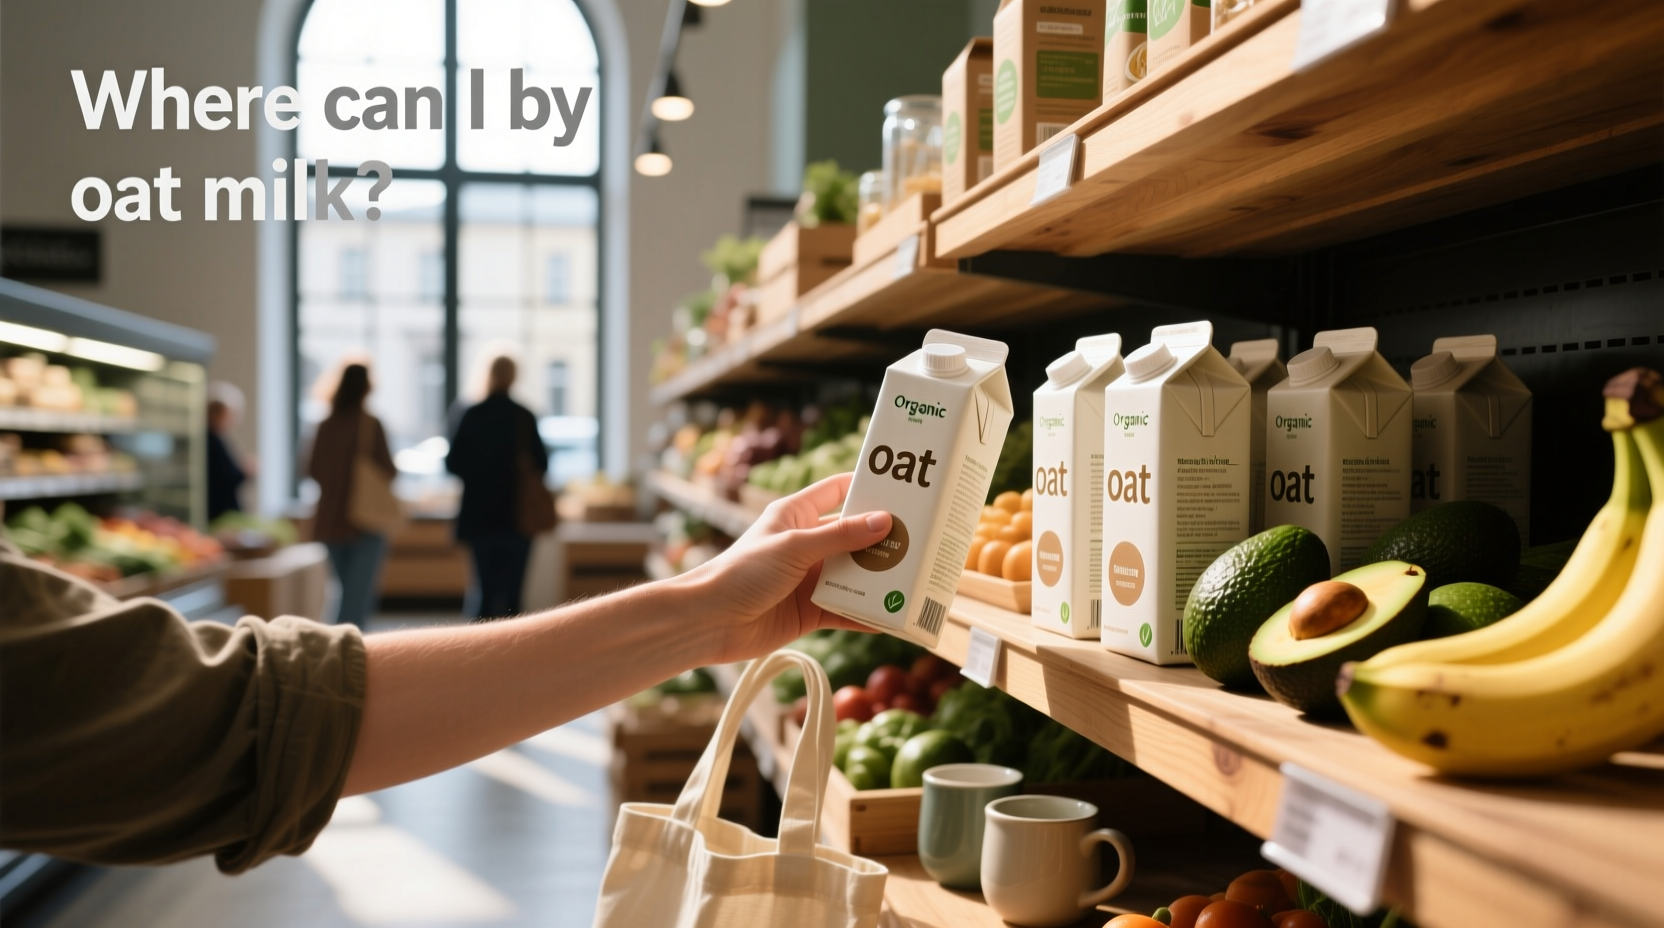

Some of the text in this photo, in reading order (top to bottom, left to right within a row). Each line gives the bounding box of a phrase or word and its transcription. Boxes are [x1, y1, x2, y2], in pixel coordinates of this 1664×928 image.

[894, 394, 947, 419] Organic
[1113, 410, 1149, 430] Organic
[1275, 413, 1312, 432] Organic
[868, 444, 937, 488] oat
[1036, 460, 1068, 497] oat
[1411, 463, 1441, 499] at
[1107, 464, 1152, 505] oat
[1270, 464, 1315, 505] oat
